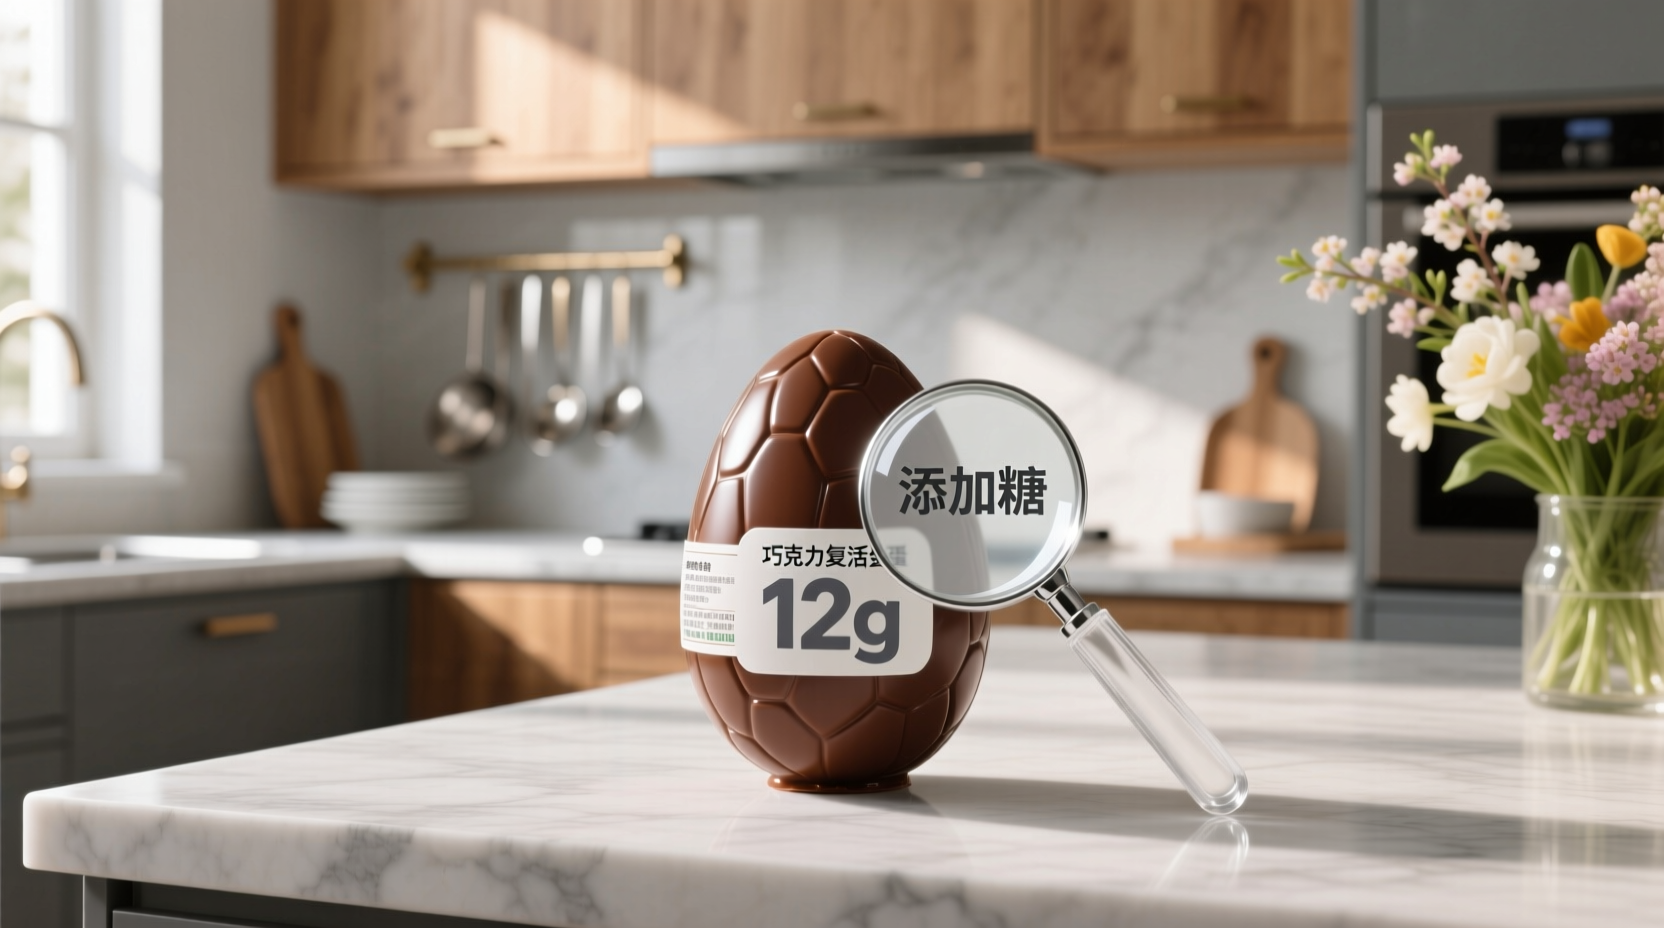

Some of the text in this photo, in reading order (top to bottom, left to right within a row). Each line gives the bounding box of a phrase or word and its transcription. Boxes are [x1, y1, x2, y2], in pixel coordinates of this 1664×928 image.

[899, 466, 1047, 515] 添加糖
[762, 577, 900, 664] 12g
